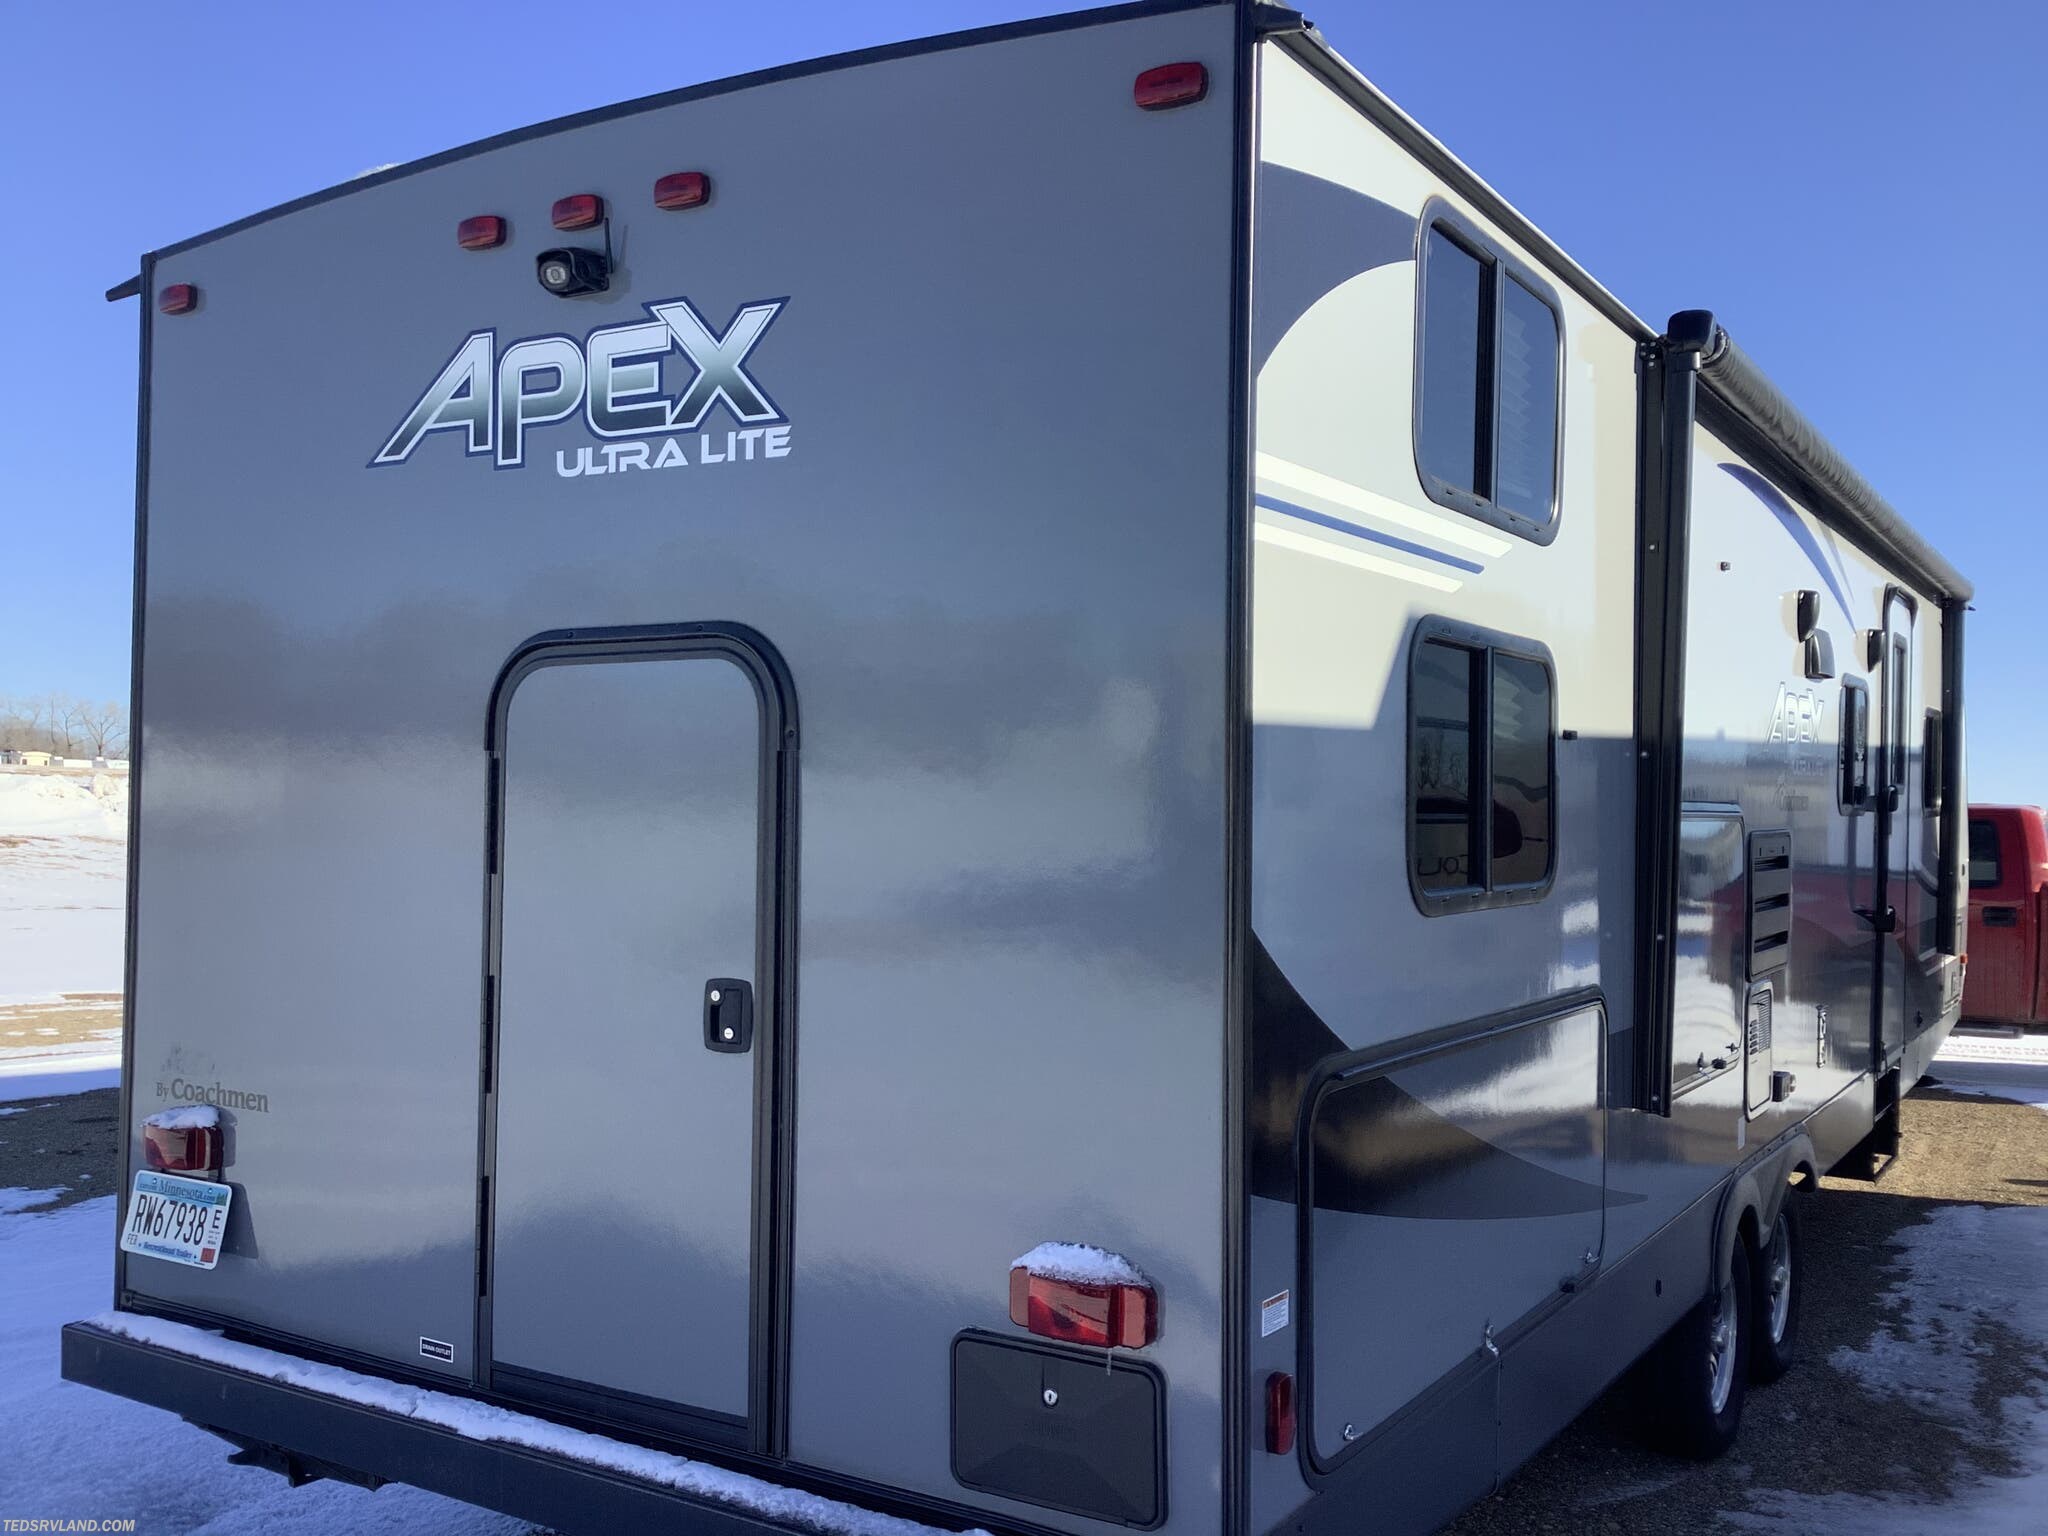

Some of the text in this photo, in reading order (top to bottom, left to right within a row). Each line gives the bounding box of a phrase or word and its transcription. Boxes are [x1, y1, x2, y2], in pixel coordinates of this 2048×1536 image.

[367, 297, 790, 470] APEX
[556, 425, 792, 478] ULTRA LITE
[156, 1078, 270, 1113] By Coachmen
[132, 1194, 208, 1246] RW67938
[212, 1209, 223, 1229] E
